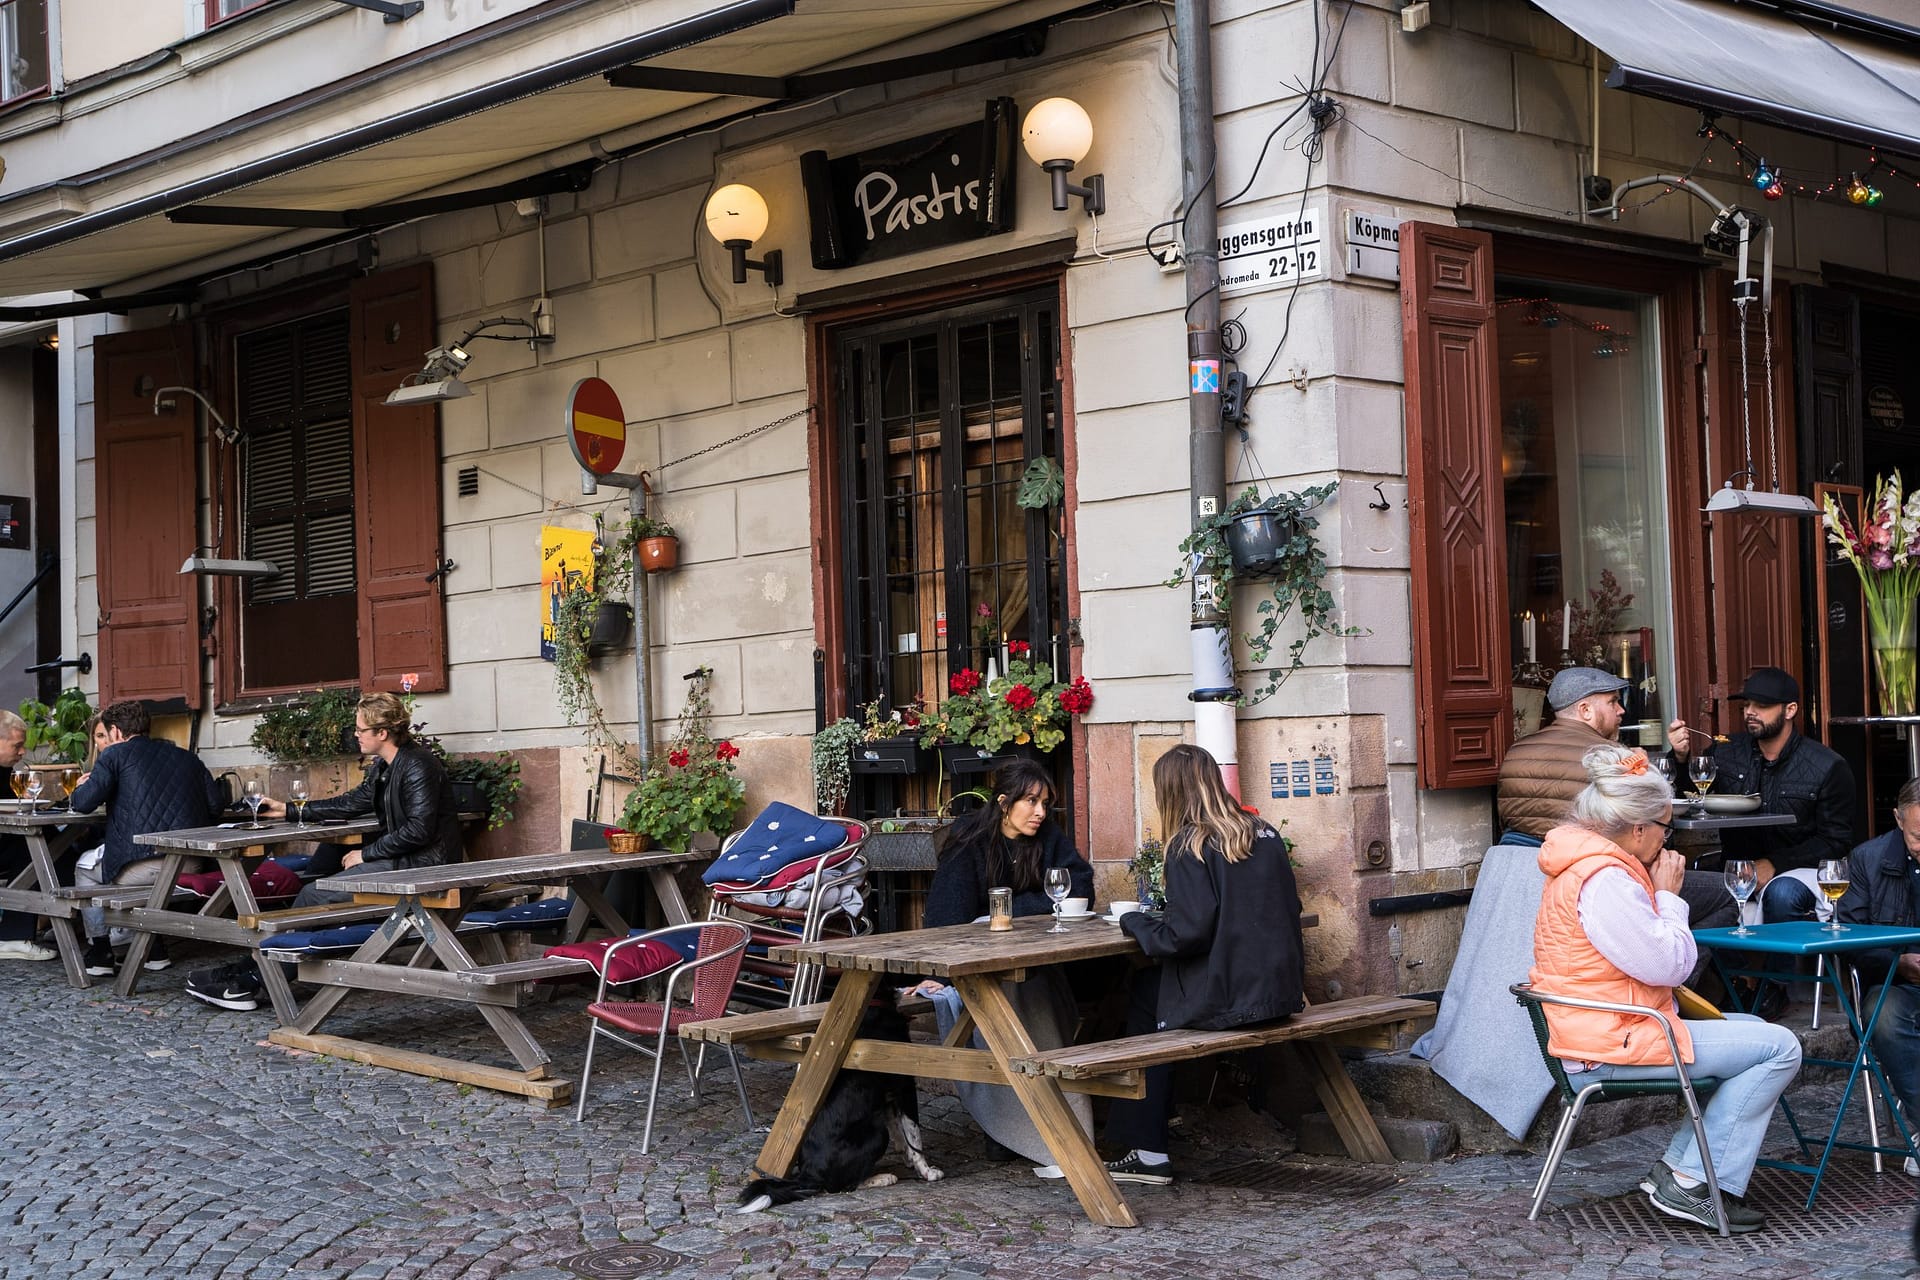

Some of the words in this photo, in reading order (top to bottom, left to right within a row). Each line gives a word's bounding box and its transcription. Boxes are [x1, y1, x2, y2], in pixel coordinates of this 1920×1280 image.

[854, 154, 980, 241] Pastis
[1355, 217, 1399, 242] Köpma
[1220, 271, 1259, 286] ndromeda
[1269, 251, 1316, 278] 22-12
[1355, 249, 1361, 269] 1
